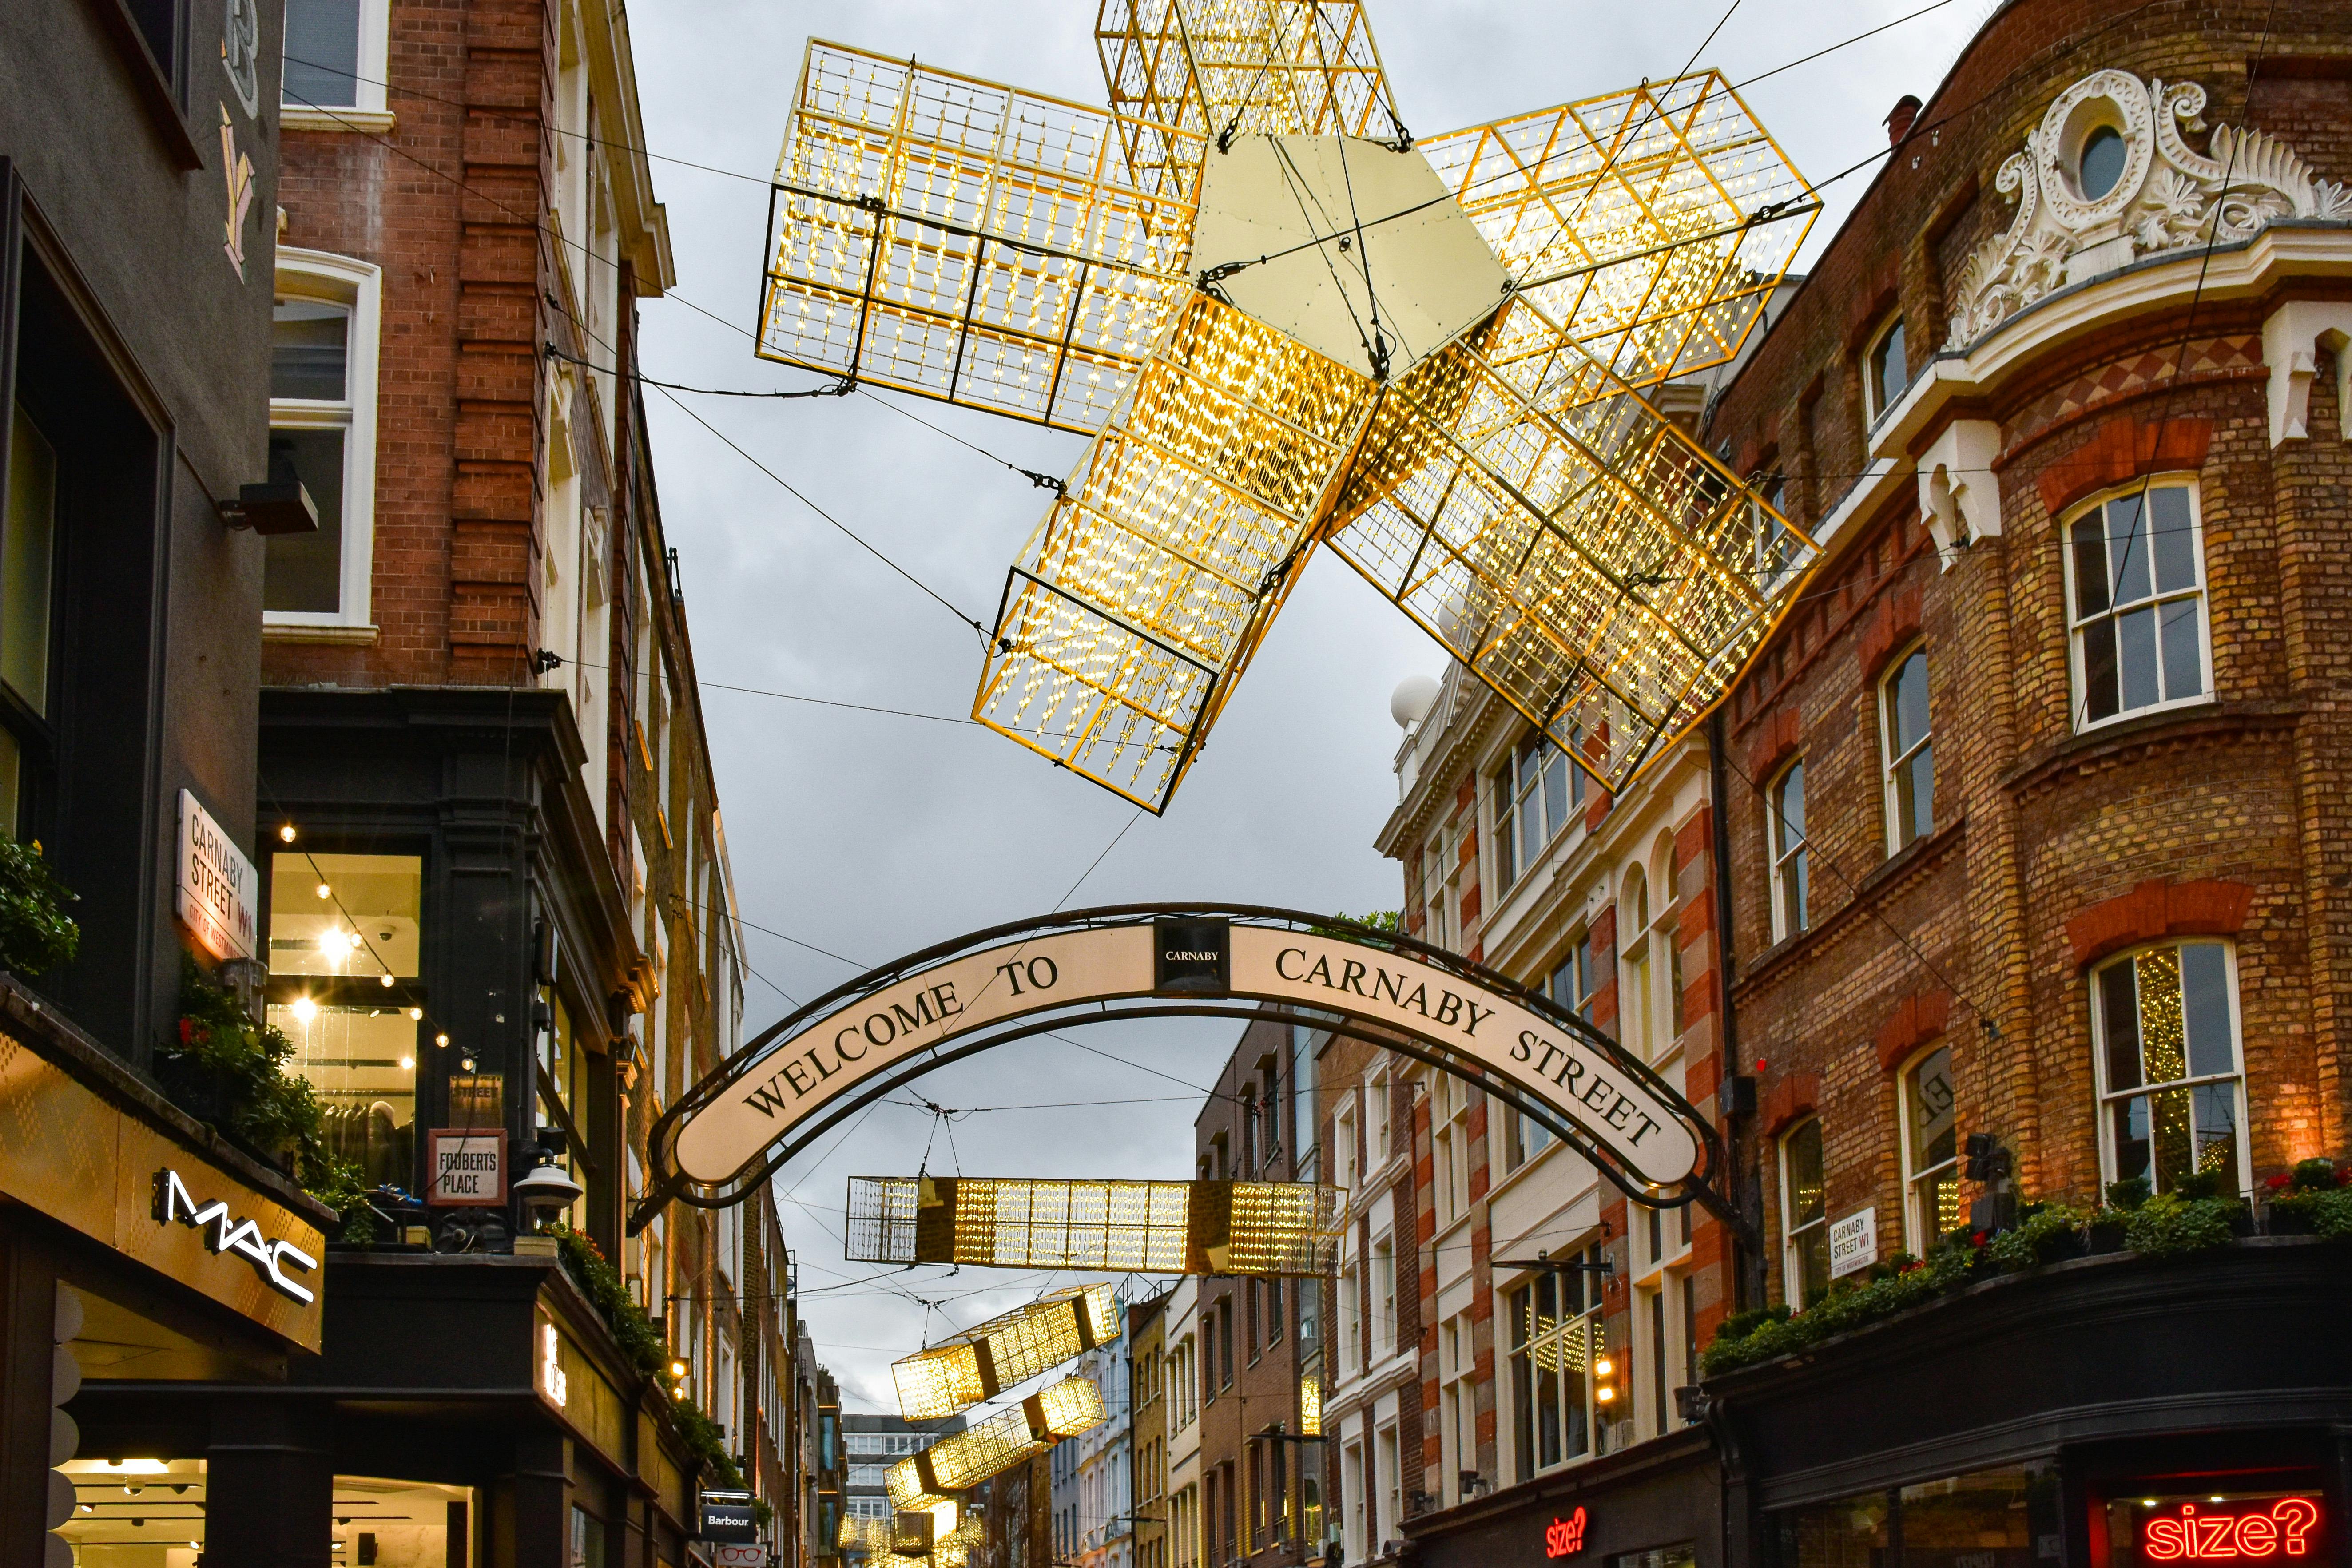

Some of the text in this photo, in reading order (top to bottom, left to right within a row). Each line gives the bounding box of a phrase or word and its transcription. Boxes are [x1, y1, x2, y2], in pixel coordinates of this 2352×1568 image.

[192, 814, 242, 894] CARNABY
[192, 853, 251, 944] STREET W1
[190, 904, 202, 926] CITY
[203, 918, 210, 934] OF
[1166, 951, 1219, 961] CARNABY
[742, 956, 1059, 1119] WELCOME TO
[1275, 948, 1661, 1149] CARNABY STREET
[440, 1151, 496, 1171] FOUBERT'S
[443, 1175, 479, 1194] PLACE
[1834, 1217, 1864, 1242] CARNABY
[1834, 1232, 1869, 1259] STREET W1
[708, 1515, 749, 1526] Barbour
[1546, 1506, 1587, 1558] size?
[2146, 1498, 2317, 1560] size?
